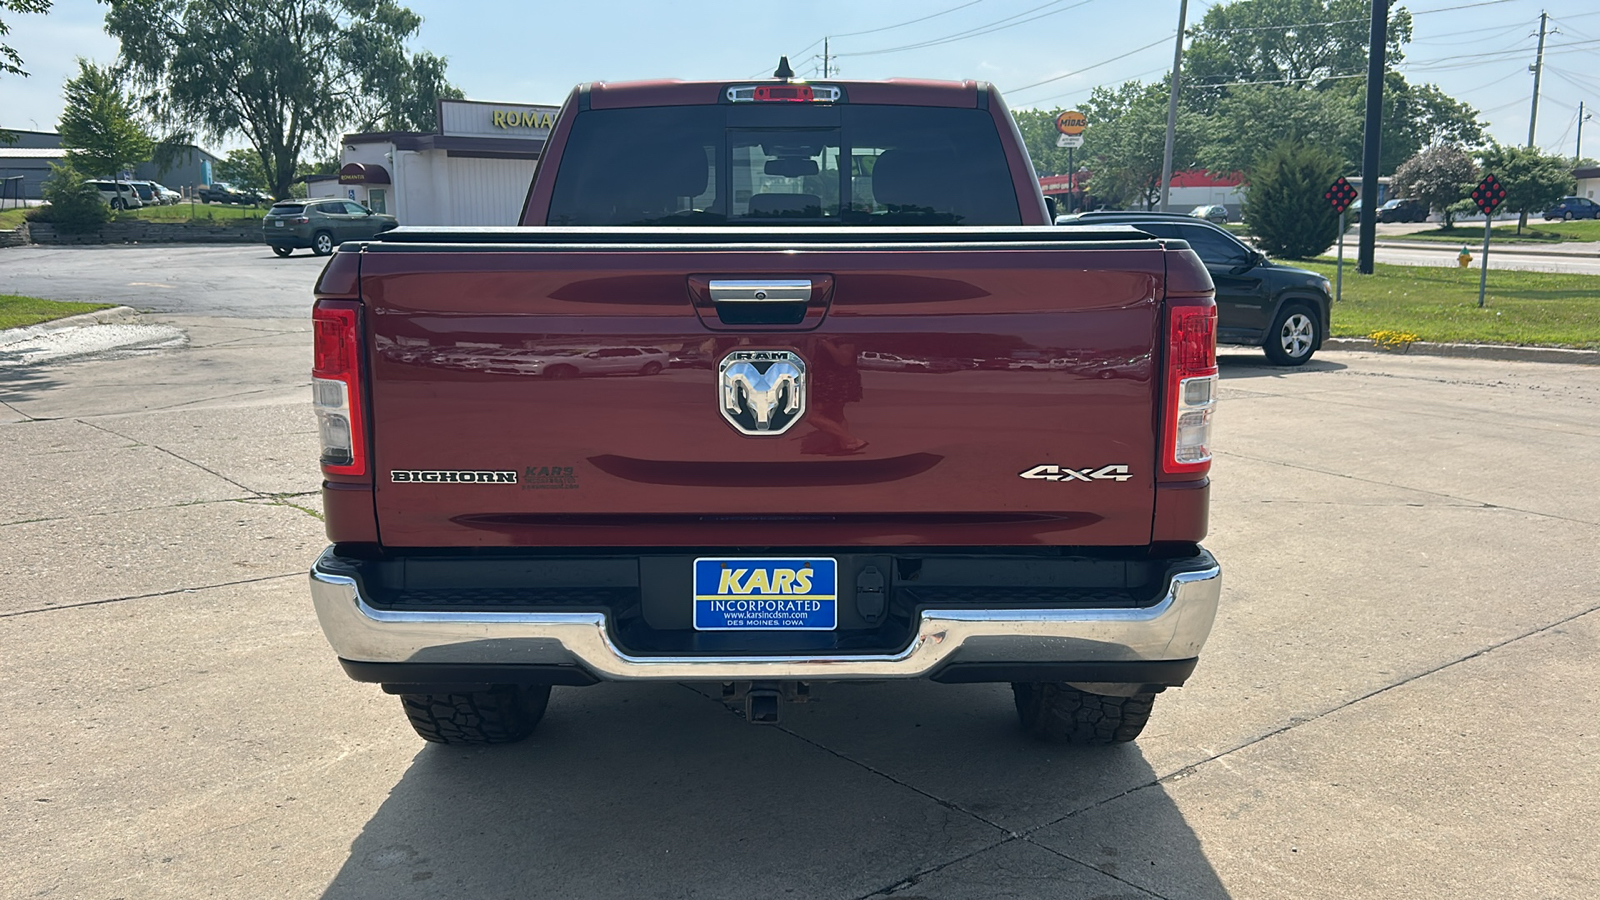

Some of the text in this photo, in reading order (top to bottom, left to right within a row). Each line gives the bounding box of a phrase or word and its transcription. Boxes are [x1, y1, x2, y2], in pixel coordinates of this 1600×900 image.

[493, 110, 557, 129] ROMA
[1060, 119, 1086, 127] MIDAS
[736, 352, 788, 360] RAM
[391, 470, 518, 484] BIGHORN
[525, 466, 574, 476] KARS
[1019, 465, 1133, 482] 4x4
[717, 568, 814, 595] KARS
[710, 600, 821, 612] INCORPORATED
[723, 611, 808, 619] www.karsincdsm.com
